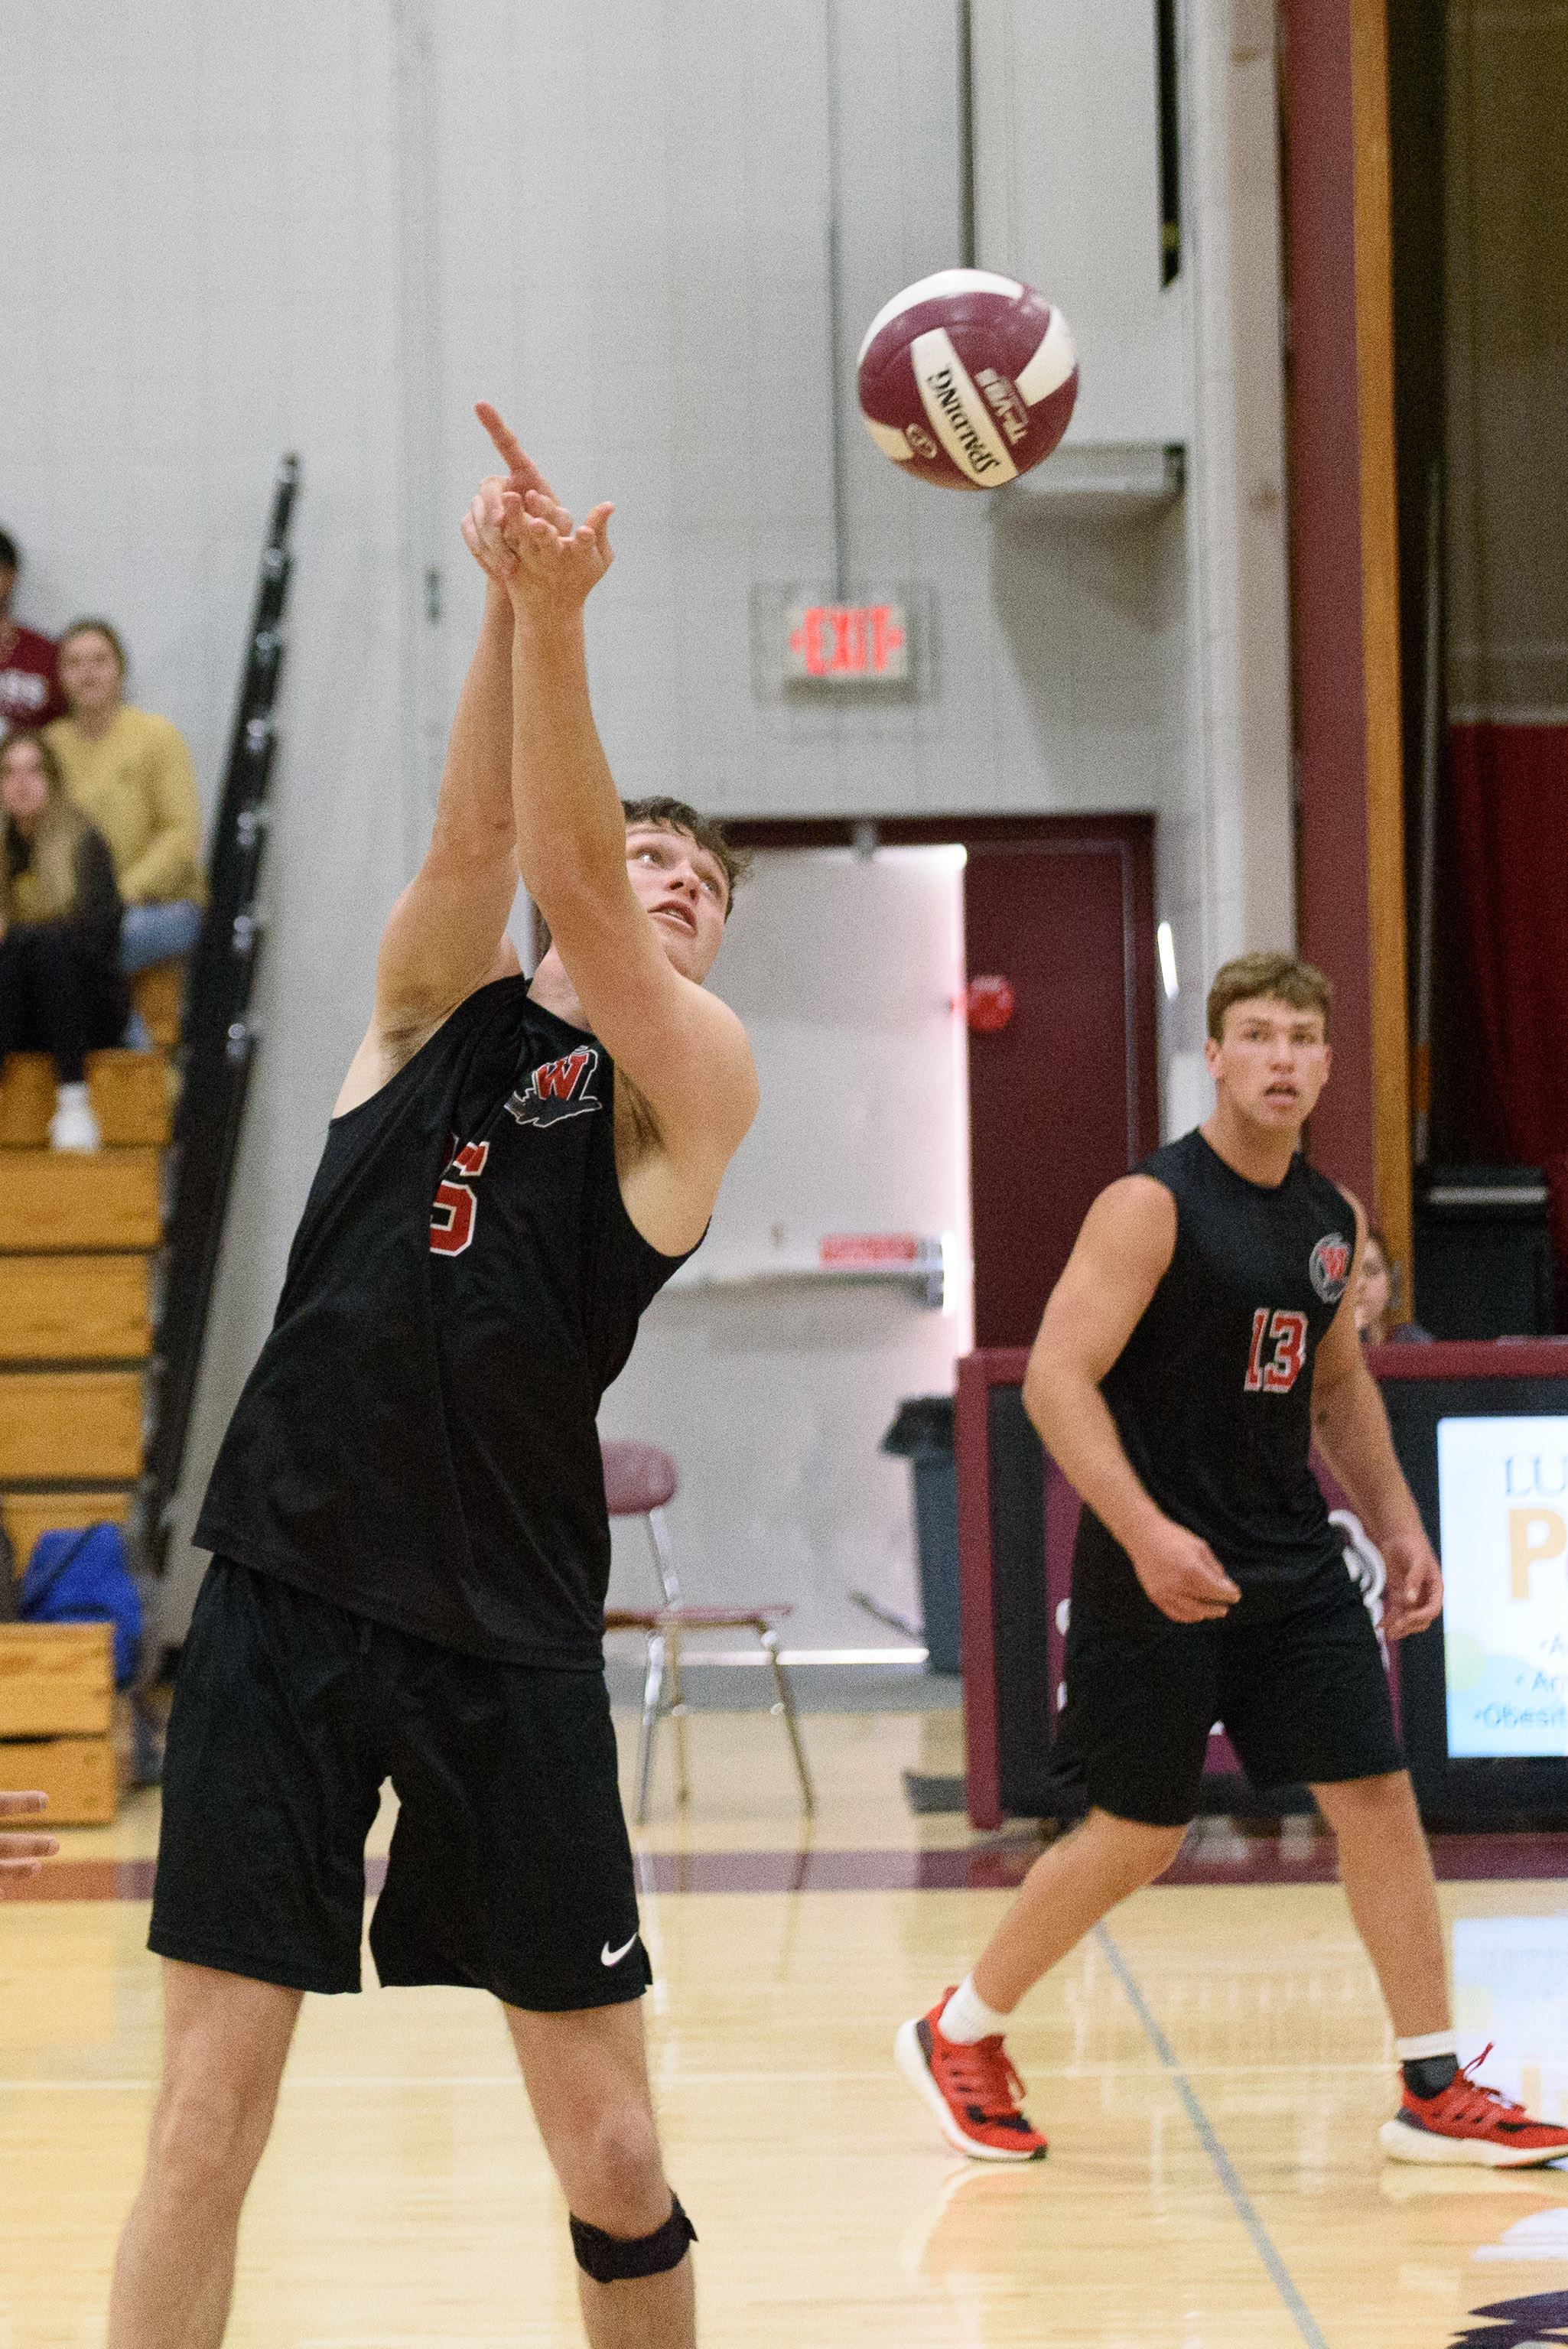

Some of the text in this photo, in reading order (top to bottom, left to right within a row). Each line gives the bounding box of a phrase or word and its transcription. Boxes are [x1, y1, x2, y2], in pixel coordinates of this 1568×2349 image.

[926, 366, 1000, 473] SPALDING
[805, 604, 891, 676] EXIT
[534, 1051, 590, 1101] W
[1244, 1307, 1309, 1394] 13
